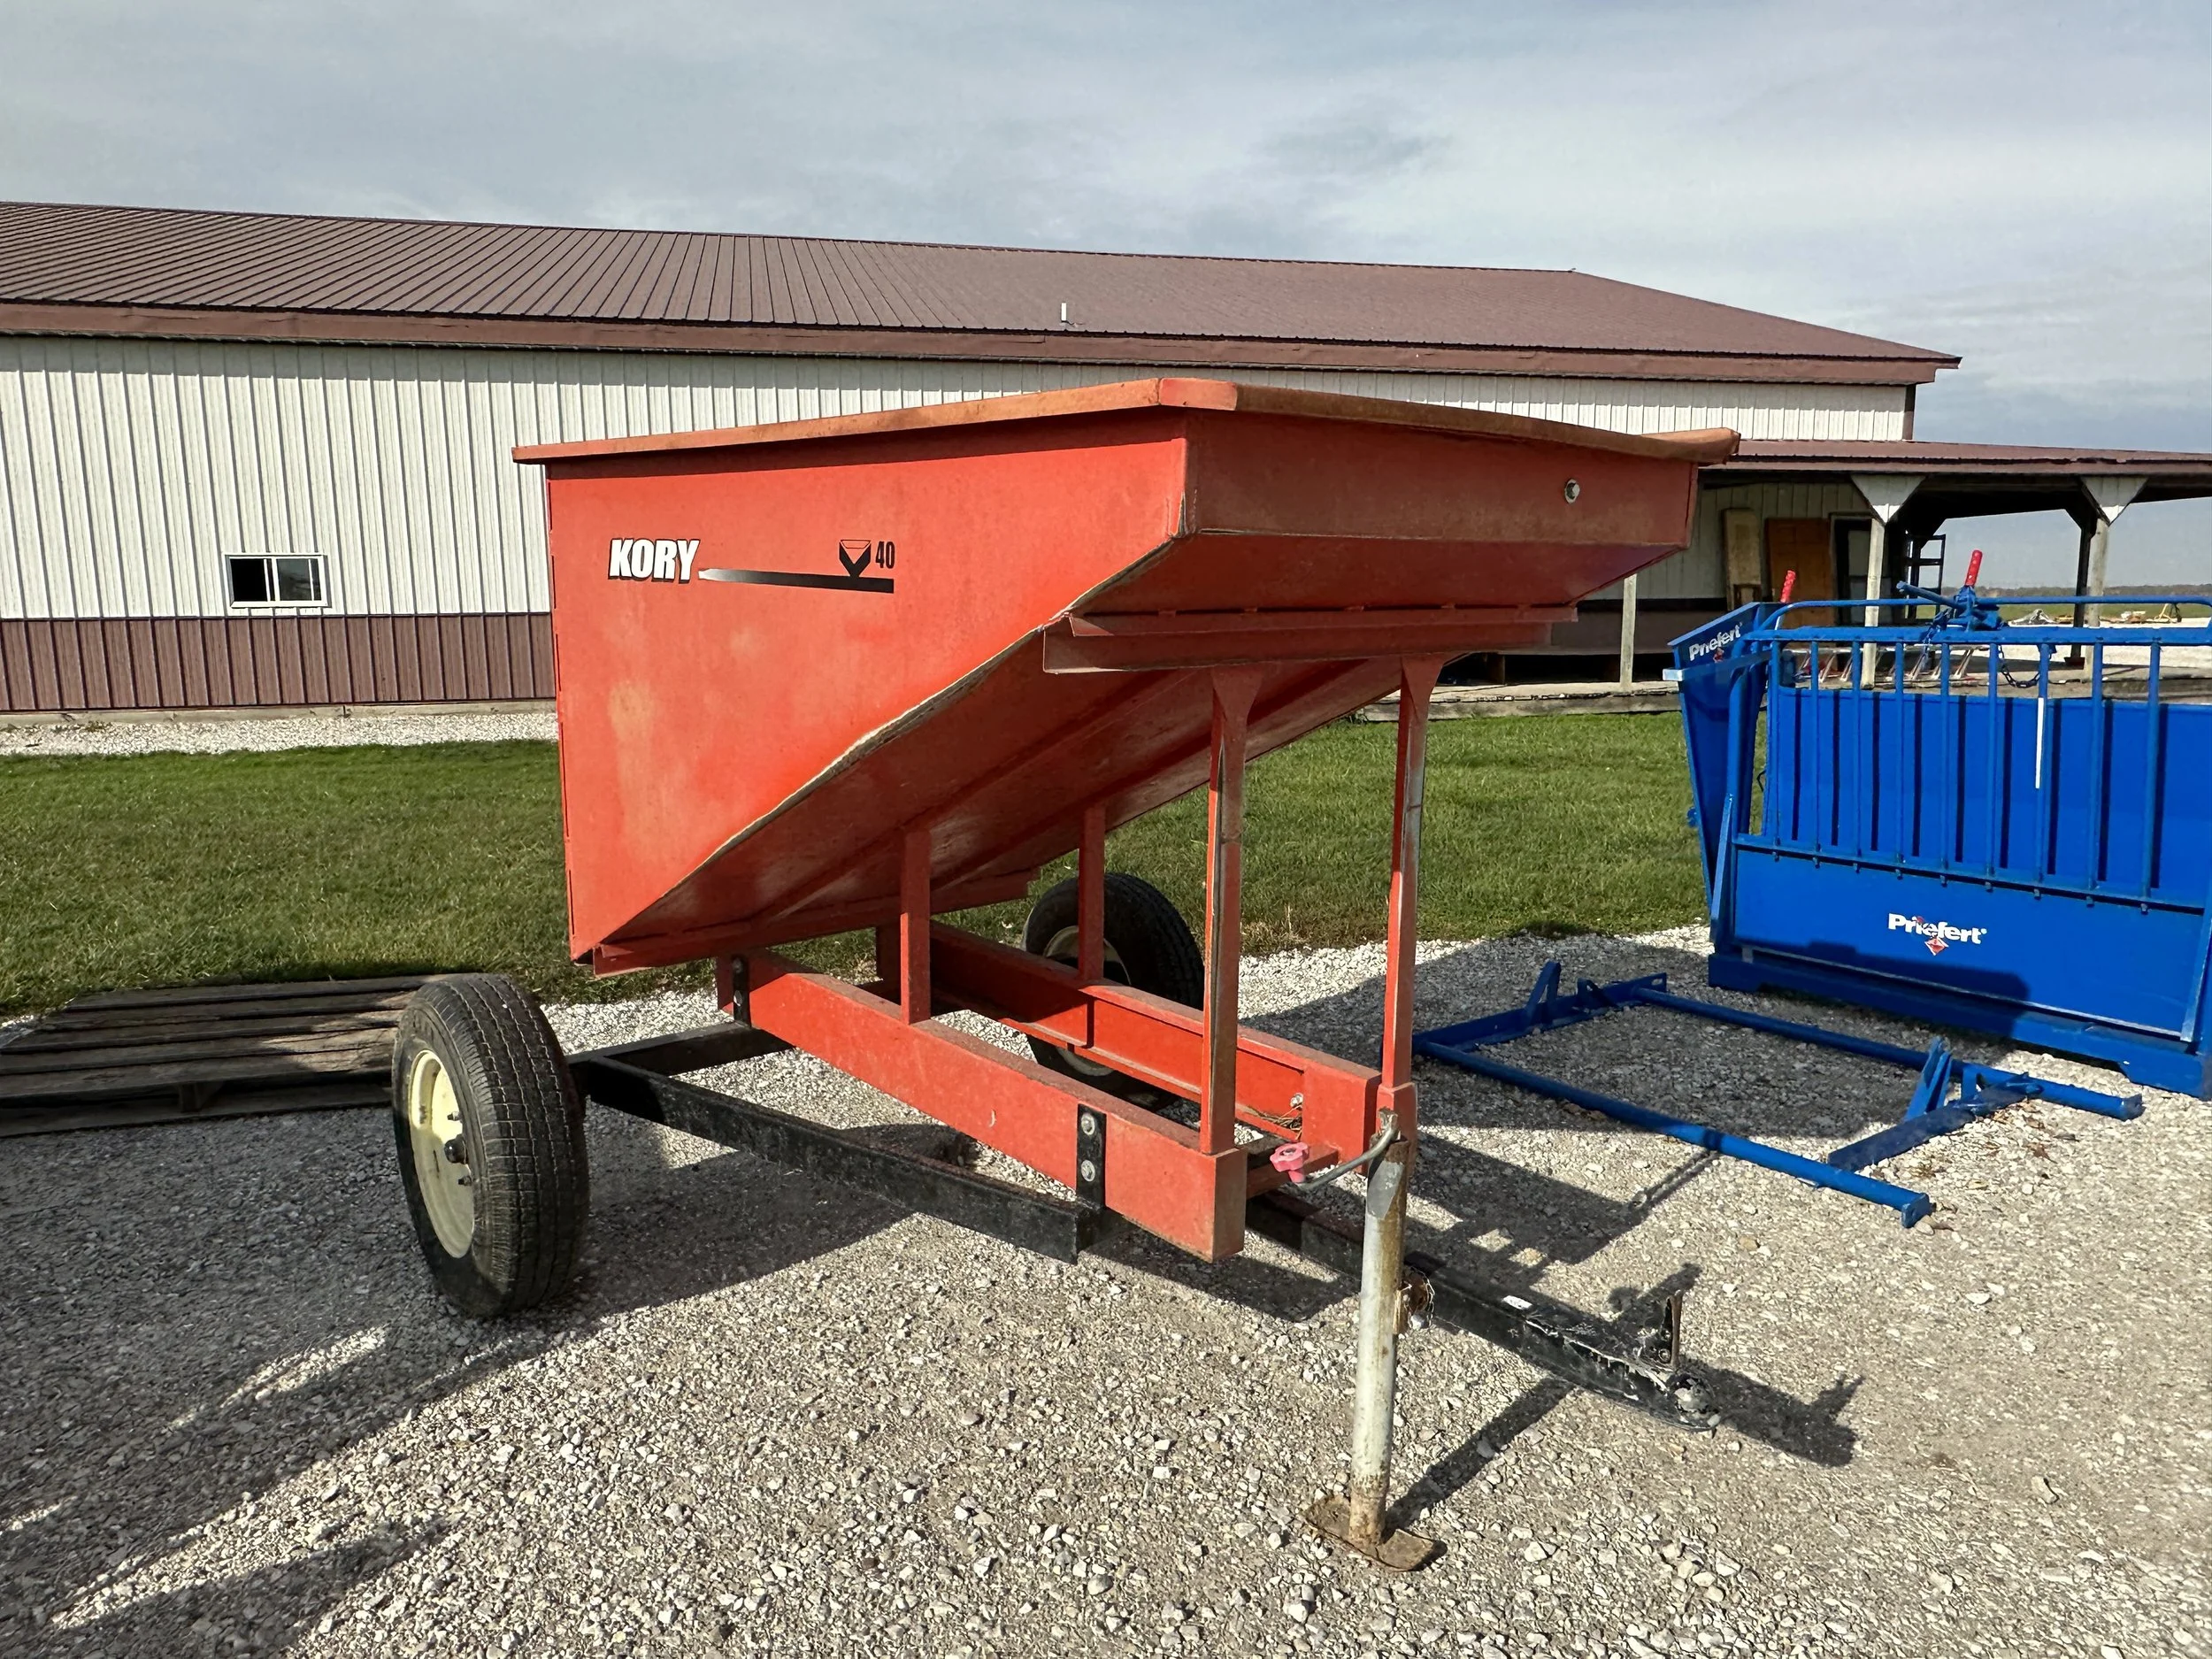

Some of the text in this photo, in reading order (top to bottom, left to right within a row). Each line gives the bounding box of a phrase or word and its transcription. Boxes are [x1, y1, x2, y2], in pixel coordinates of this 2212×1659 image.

[608, 538, 895, 584] KORY 40
[1888, 913, 1982, 944] Priefert
